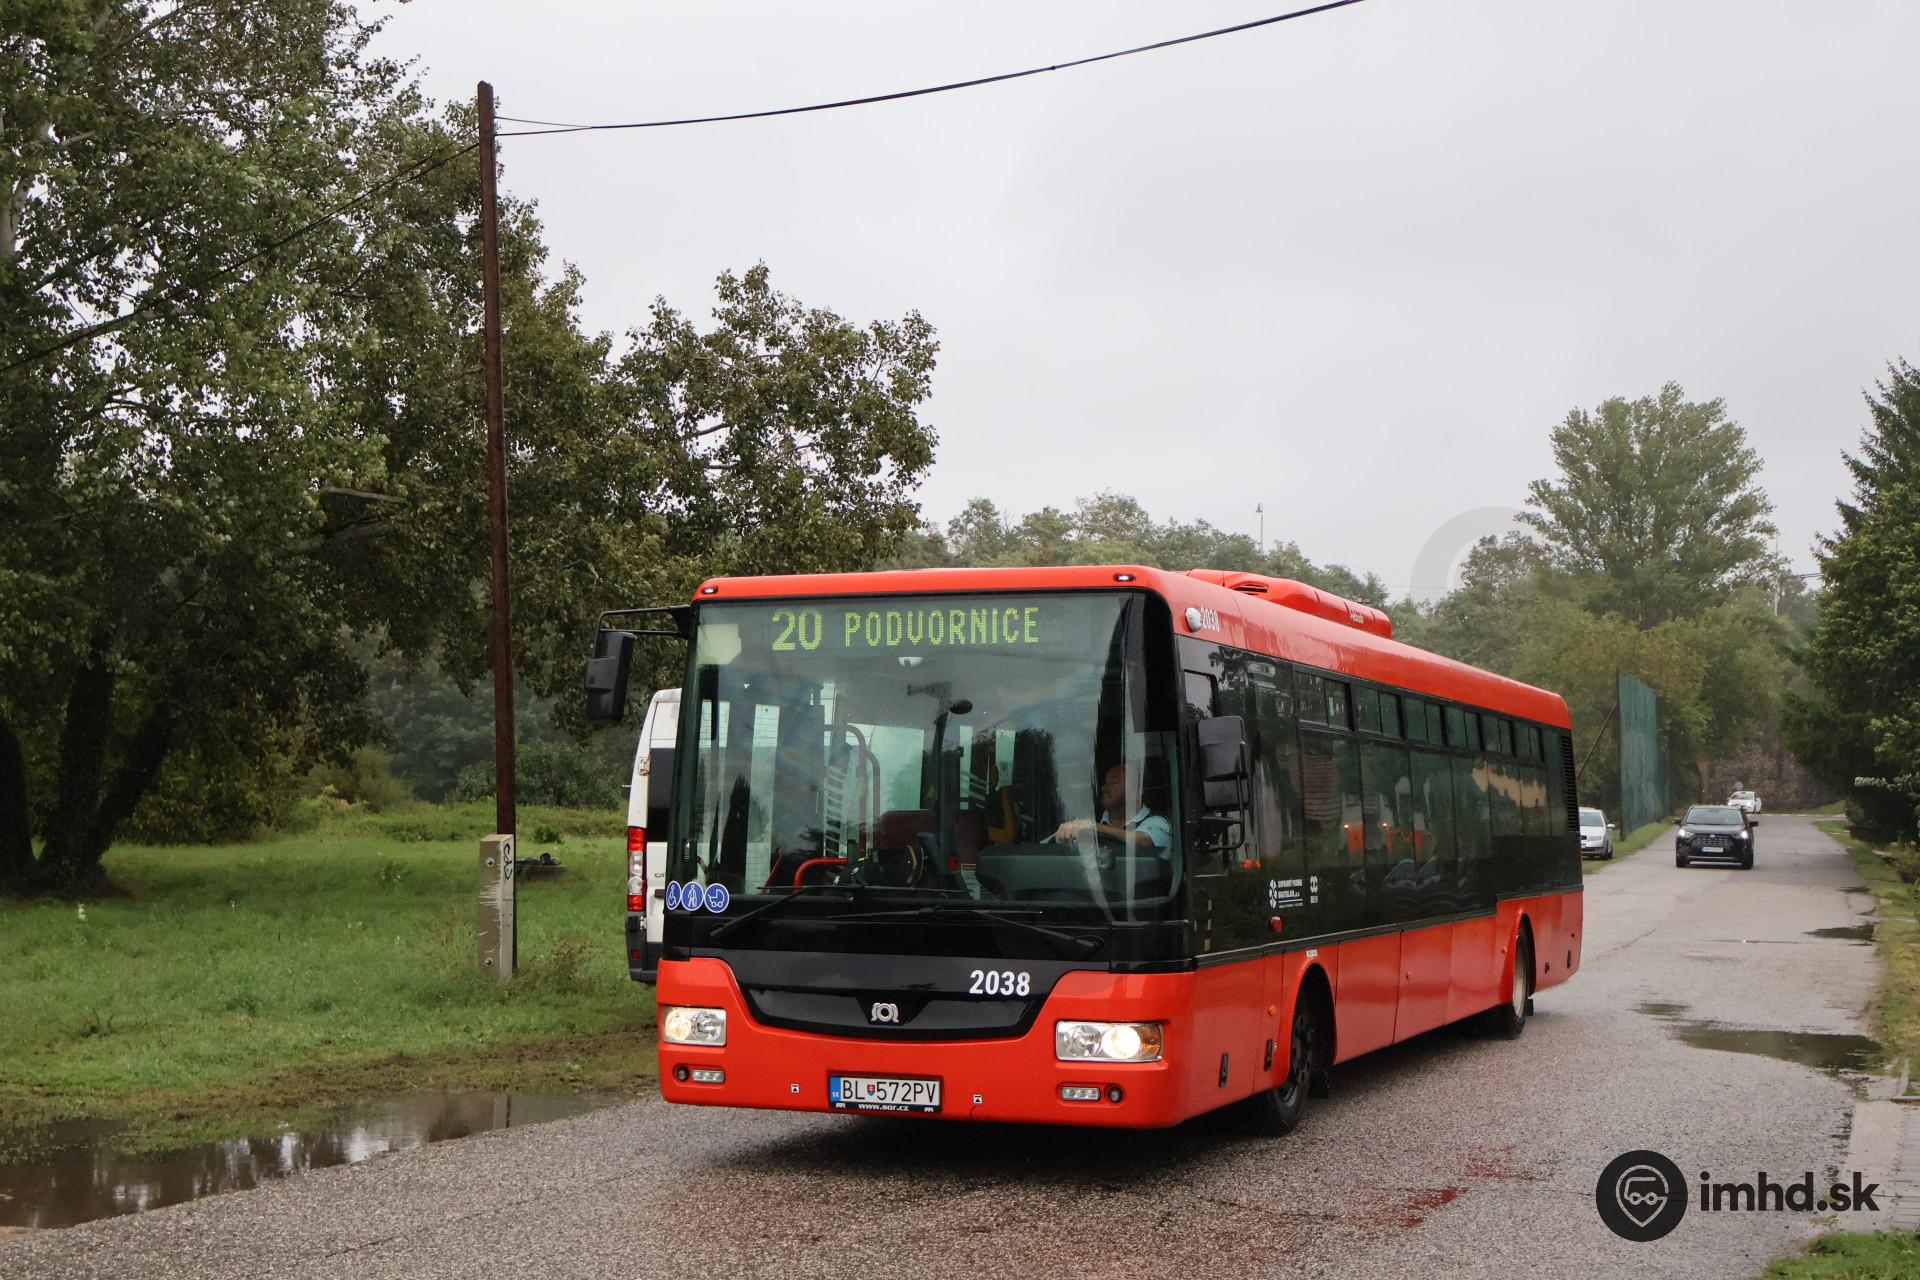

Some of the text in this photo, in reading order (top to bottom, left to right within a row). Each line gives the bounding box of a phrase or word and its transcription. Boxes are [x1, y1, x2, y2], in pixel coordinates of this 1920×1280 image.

[772, 607, 1039, 650] 20 PODVORNICE
[1200, 606, 1220, 633] 2038
[969, 969, 1031, 997] 2038
[858, 1103, 909, 1112] www.sor.cz
